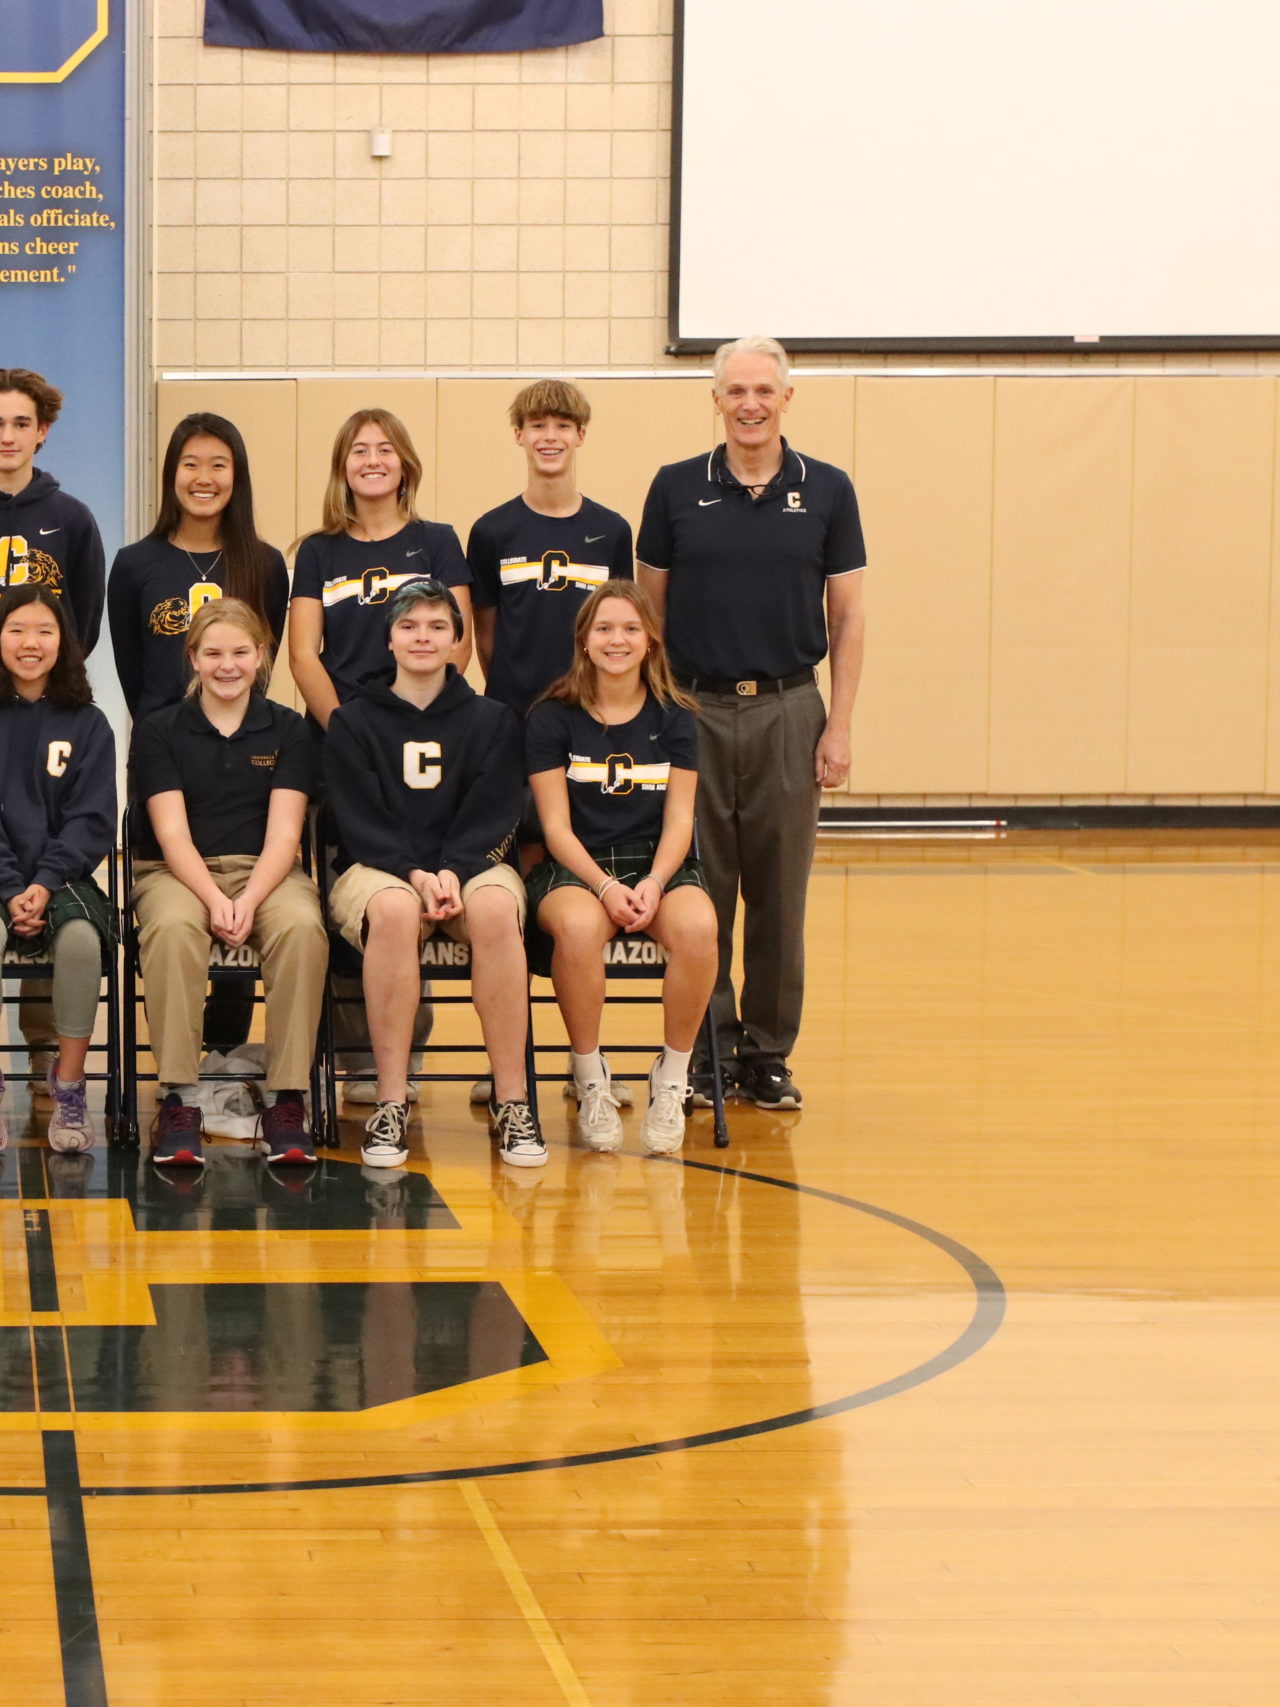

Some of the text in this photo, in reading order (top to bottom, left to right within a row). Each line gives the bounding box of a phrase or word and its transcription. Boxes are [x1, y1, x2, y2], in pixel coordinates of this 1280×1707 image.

[53, 153, 101, 175] play,
[40, 181, 104, 202] coach,
[30, 209, 116, 230] officiate,
[24, 237, 79, 255] cheer
[787, 491, 801, 508] C
[46, 740, 72, 778] C
[403, 740, 442, 789] C
